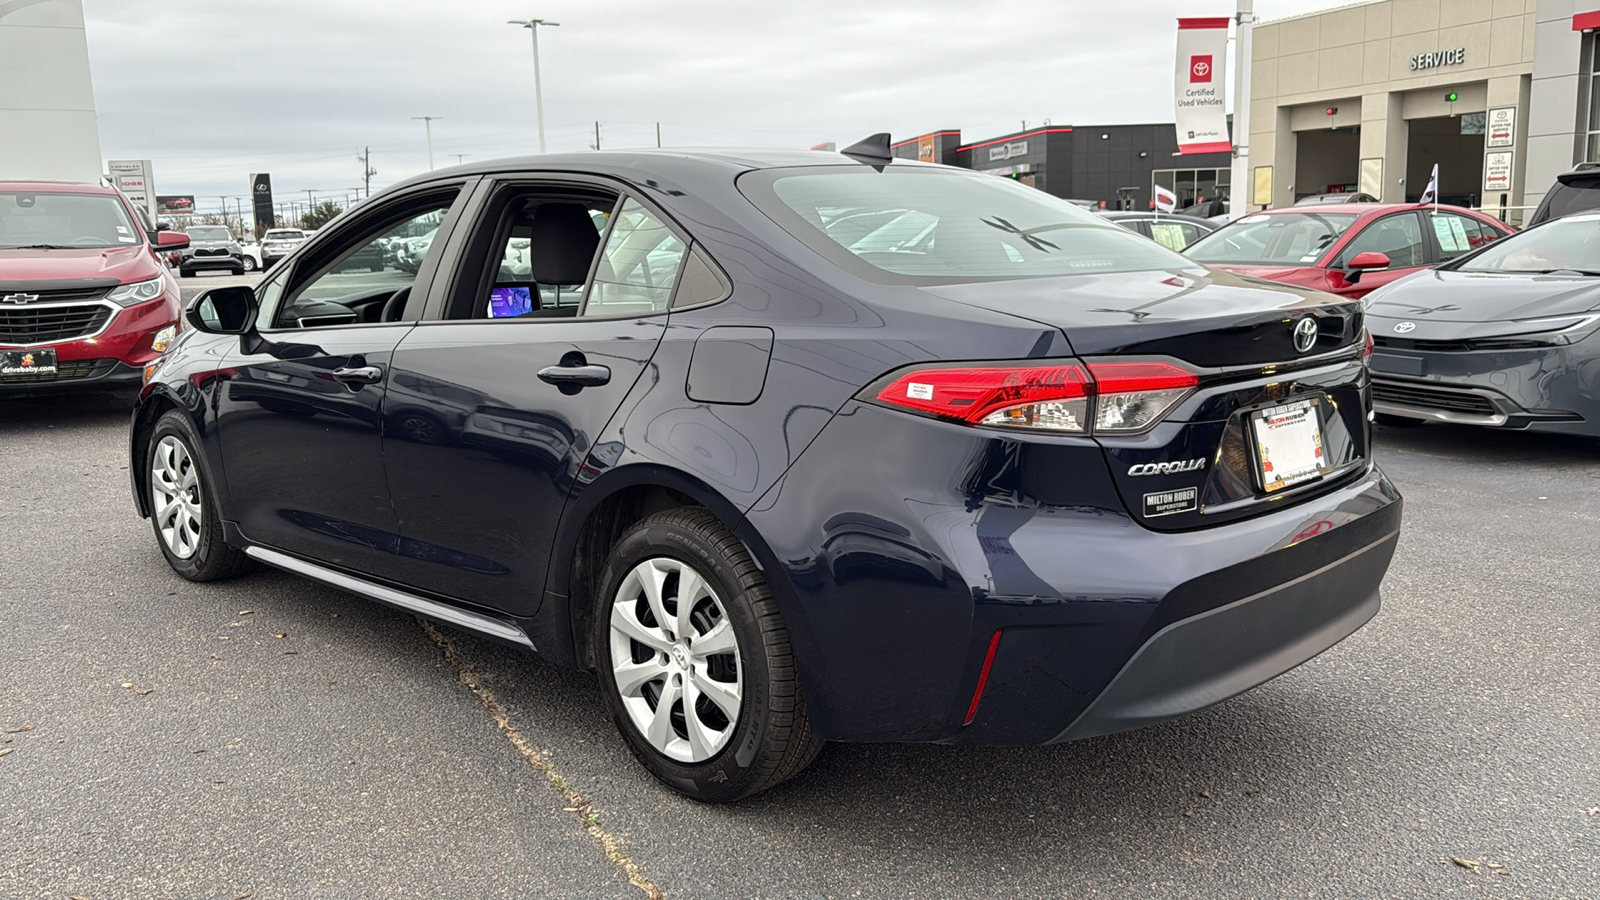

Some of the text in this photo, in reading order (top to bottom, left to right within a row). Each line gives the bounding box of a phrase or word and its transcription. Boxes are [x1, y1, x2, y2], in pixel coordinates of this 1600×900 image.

[1409, 48, 1465, 70] SERVICE
[1186, 88, 1215, 97] Certified
[1178, 98, 1223, 107] Used Vehicles
[1285, 413, 1305, 421] RUBEN
[1275, 418, 1306, 428] SUPERSTORE
[1127, 457, 1206, 476] COROLLA
[1147, 490, 1194, 506] MILTON RUBEN
[1156, 501, 1188, 511] SUPERSTORE
[666, 532, 722, 578] GENERAL
